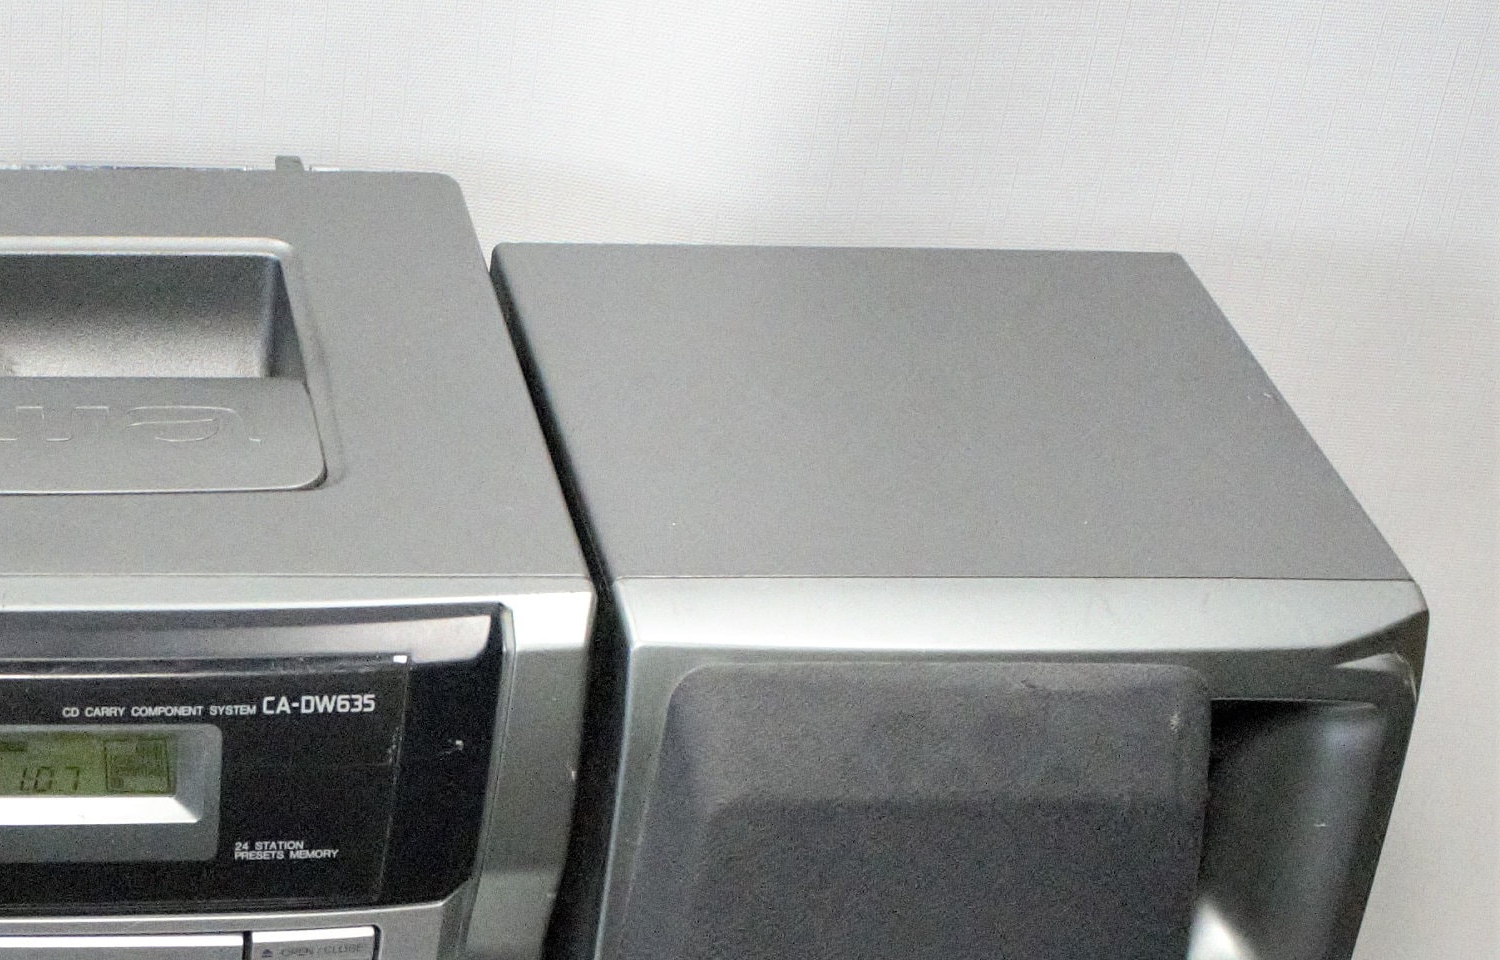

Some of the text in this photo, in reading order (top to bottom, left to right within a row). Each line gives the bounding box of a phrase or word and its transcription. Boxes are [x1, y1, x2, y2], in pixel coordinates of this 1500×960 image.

[62, 694, 376, 718] CD CARRY COMPONENT SYSTEM CA-DW635
[235, 840, 304, 851] 24 STATION
[234, 848, 339, 861] PRESETS MEMORY
